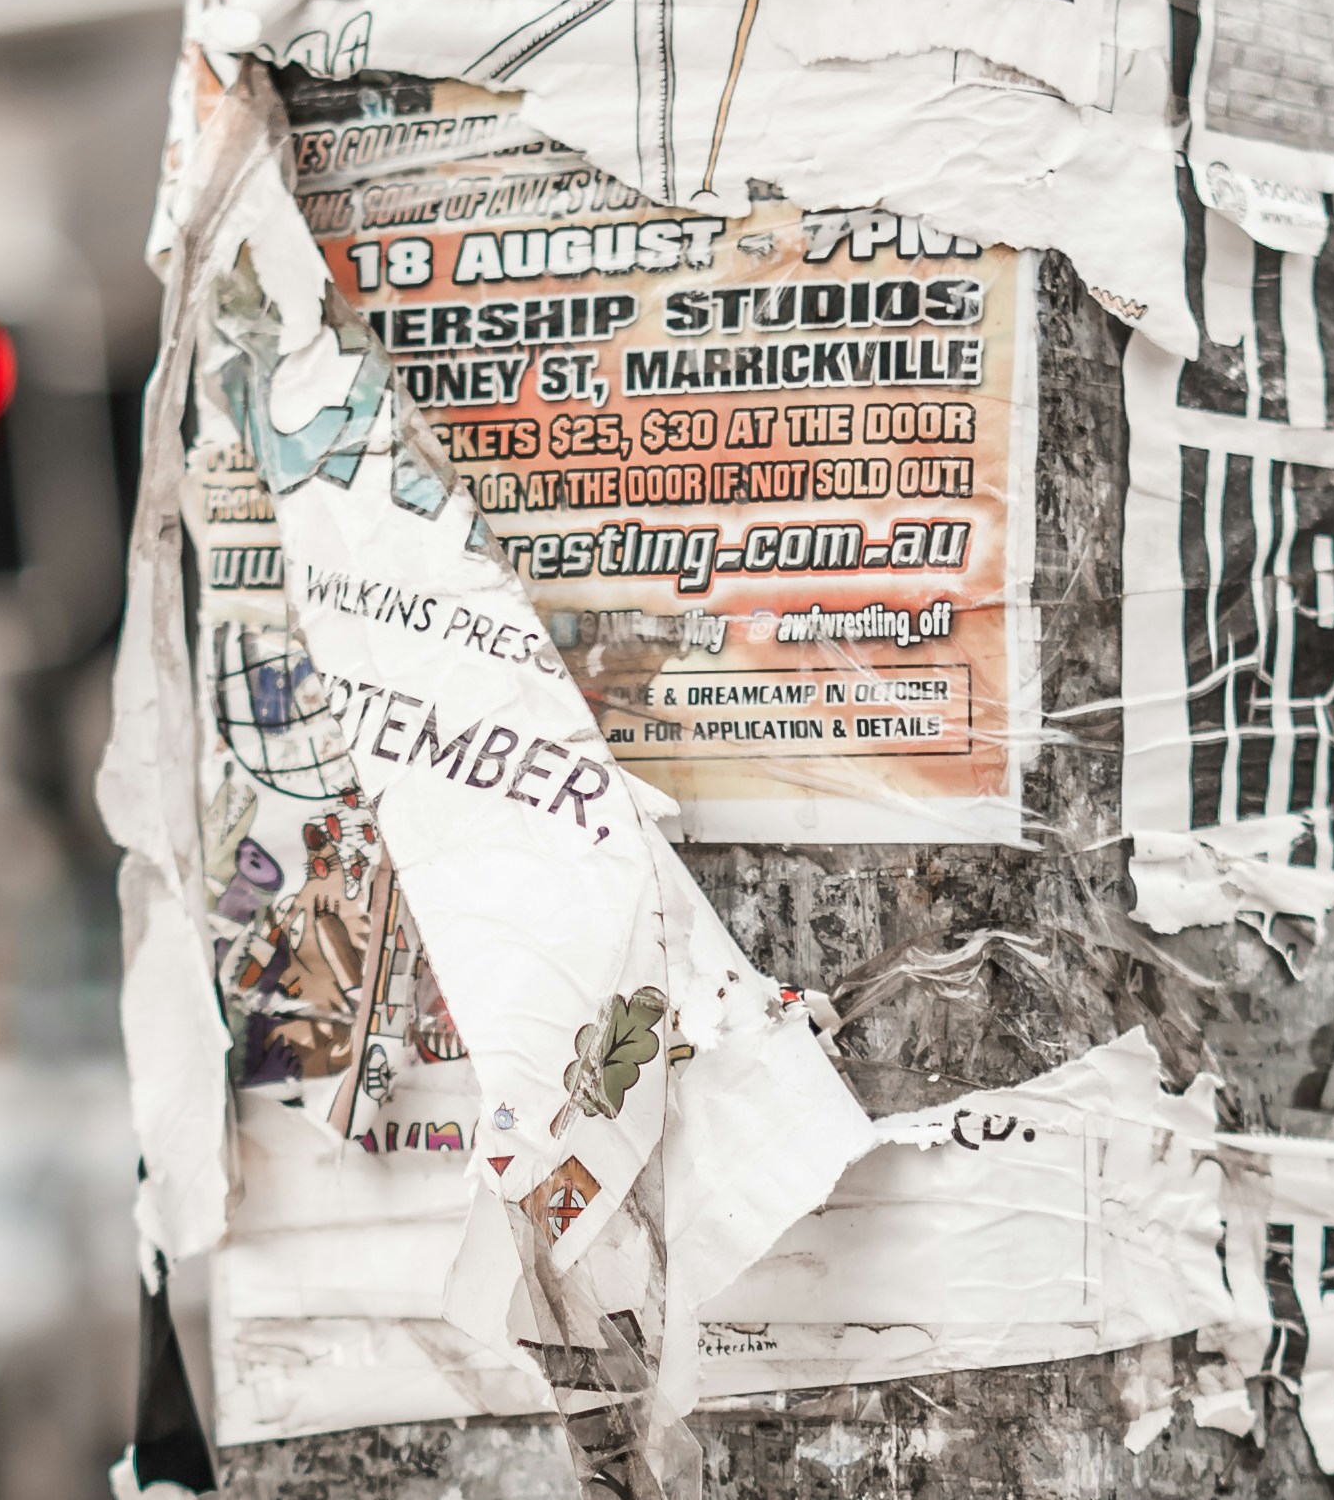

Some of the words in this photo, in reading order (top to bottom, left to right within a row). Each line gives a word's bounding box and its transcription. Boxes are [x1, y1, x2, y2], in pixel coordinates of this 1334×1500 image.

[453, 217, 725, 285] AUGUST
[667, 279, 983, 334] STUDIOS
[538, 352, 609, 407] ST,
[624, 338, 982, 395] MARRICKVILLE
[549, 413, 631, 460] $25,
[641, 408, 718, 455] $30
[725, 406, 778, 449] AT
[785, 403, 854, 447] THE
[863, 402, 976, 446] DOOR
[480, 472, 520, 514] OR
[525, 470, 563, 511] AT
[565, 466, 622, 508] THE
[626, 463, 708, 506] DOOR
[710, 462, 744, 504] IF
[747, 460, 809, 504] NOT
[814, 459, 892, 500] SOLD
[898, 457, 975, 499] OUT!
[308, 564, 438, 633] WILKINS
[442, 606, 569, 681] PRESC
[688, 684, 816, 706] DREAMCAMP
[826, 683, 847, 704] IN
[855, 680, 949, 703] OCTOBER
[644, 722, 683, 743] FOR
[693, 718, 824, 742] APPLICATION
[833, 718, 847, 738] &
[856, 716, 941, 739] DETAILS
[319, 671, 611, 846] PTEMBER,
[697, 1333, 778, 1357] Petersham
